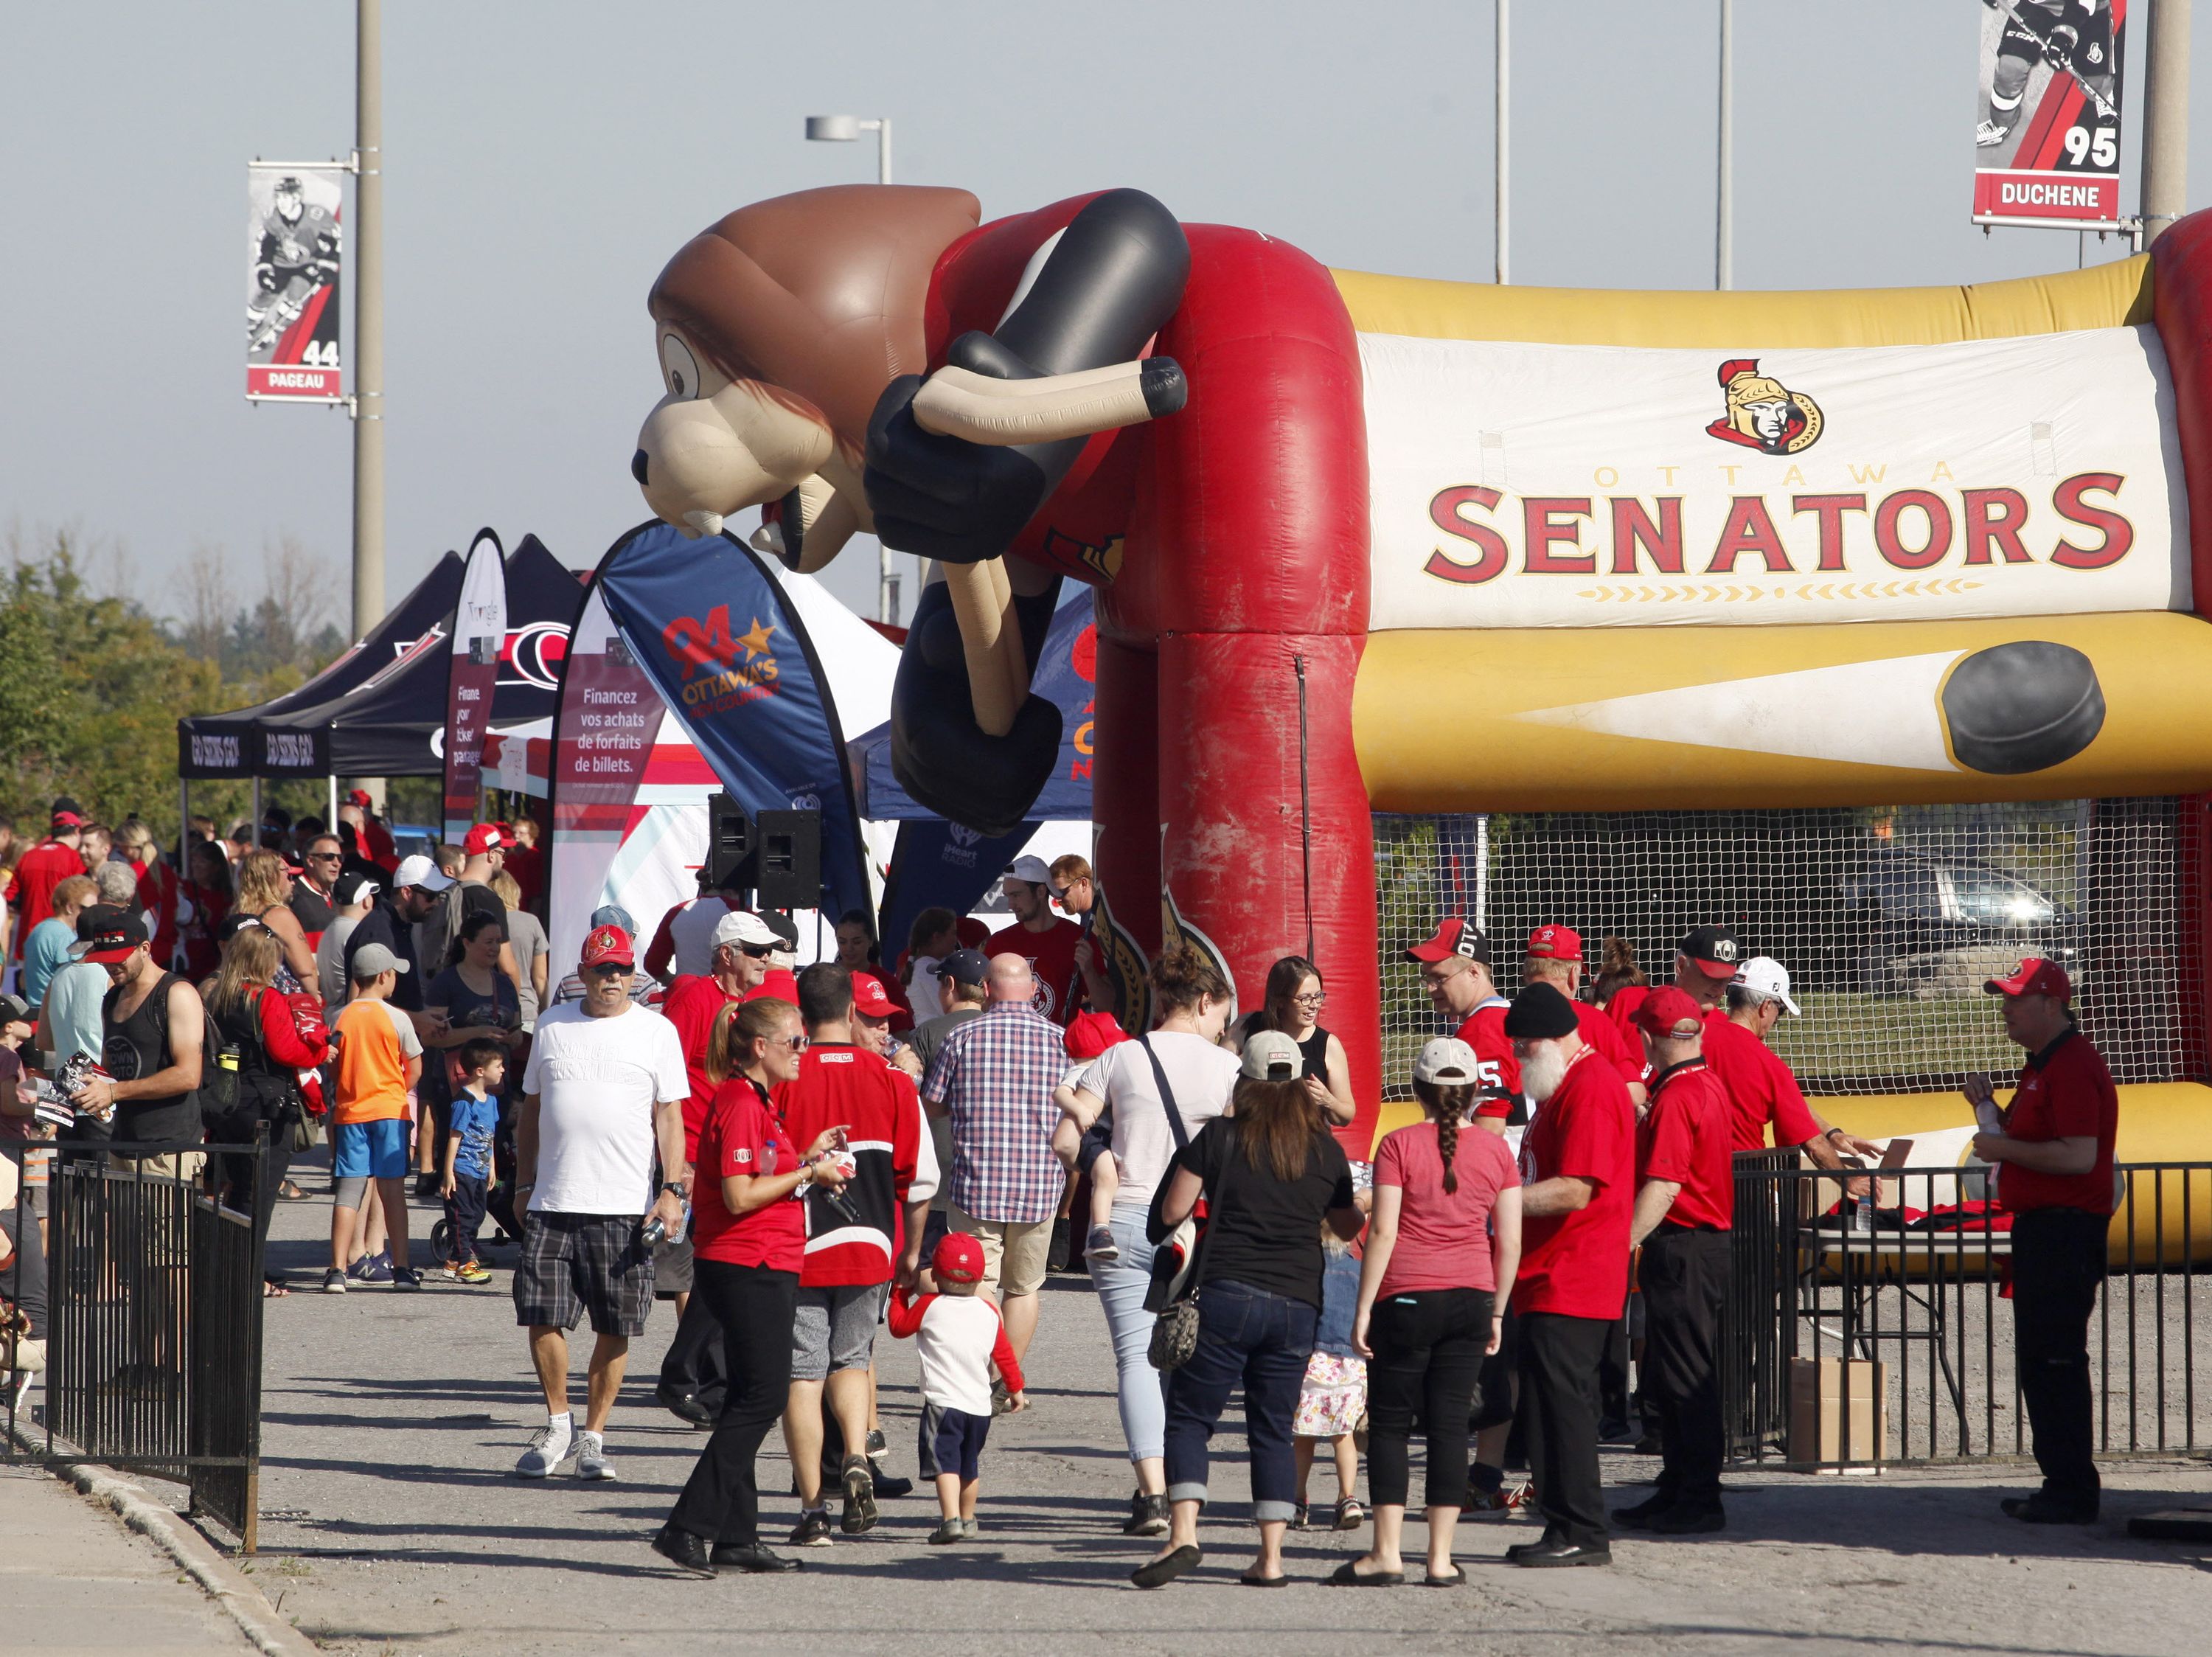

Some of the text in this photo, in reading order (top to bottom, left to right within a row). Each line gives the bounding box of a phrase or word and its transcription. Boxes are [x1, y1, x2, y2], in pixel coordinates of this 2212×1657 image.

[2065, 125, 2117, 167] 95
[2001, 182, 2100, 208] DUCHENE
[302, 339, 339, 367] 44
[268, 372, 324, 389] PAGEAU
[1593, 460, 1955, 488] OTTAWA
[1420, 470, 2137, 586] SENATORS
[662, 603, 744, 681] 94
[583, 687, 638, 704] Financez
[682, 658, 779, 706] OTTAWA'S
[581, 711, 644, 727] vos achats
[578, 733, 641, 750] de forfaits
[574, 756, 633, 773] de billets.
